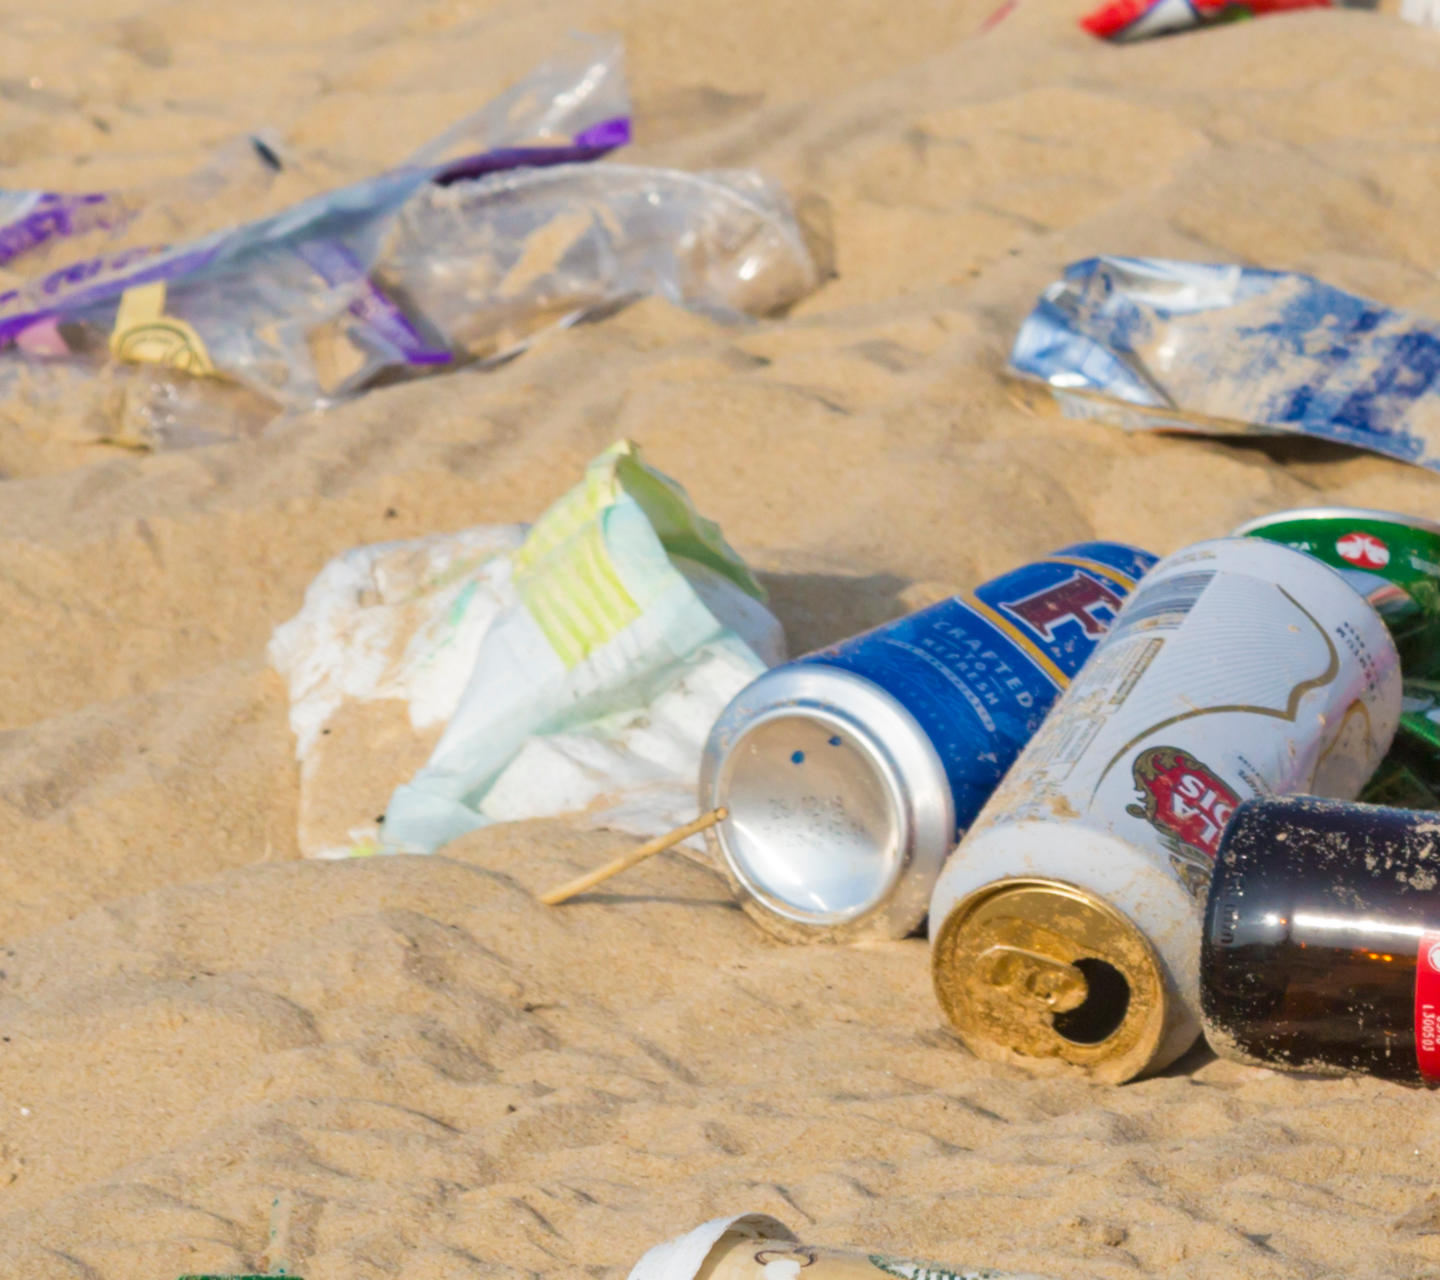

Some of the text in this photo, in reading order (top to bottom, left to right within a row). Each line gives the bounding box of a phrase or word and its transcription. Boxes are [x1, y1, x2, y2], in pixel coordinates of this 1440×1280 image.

[920, 634, 1001, 706] REFRESH
[931, 616, 1036, 710] CRAFTED
[963, 649, 988, 674] TO
